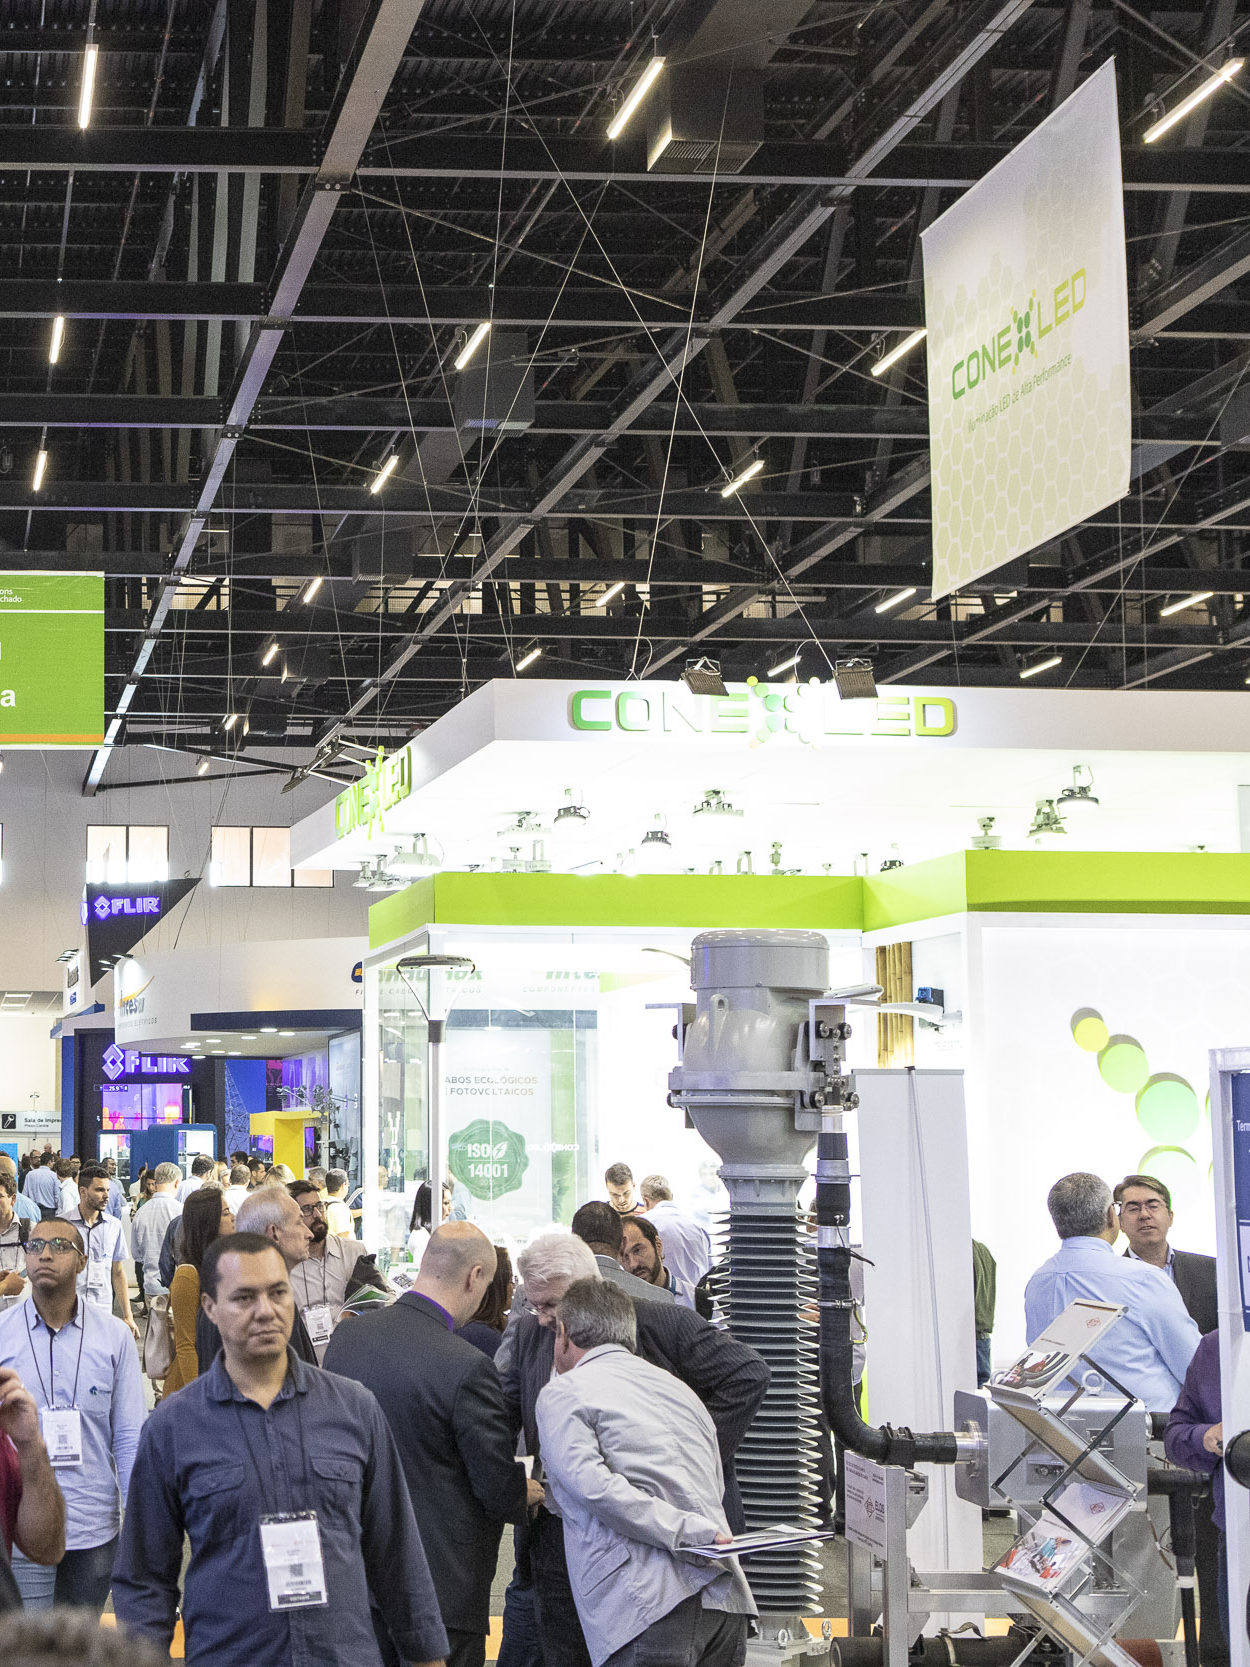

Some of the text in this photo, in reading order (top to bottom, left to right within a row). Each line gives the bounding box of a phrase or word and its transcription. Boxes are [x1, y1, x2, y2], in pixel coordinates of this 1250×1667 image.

[111, 897, 160, 914] FLIR
[125, 1051, 190, 1073] FLIR
[445, 1076, 472, 1084] ABOS
[467, 1143, 490, 1158] ISO
[468, 1163, 509, 1178] 14001
